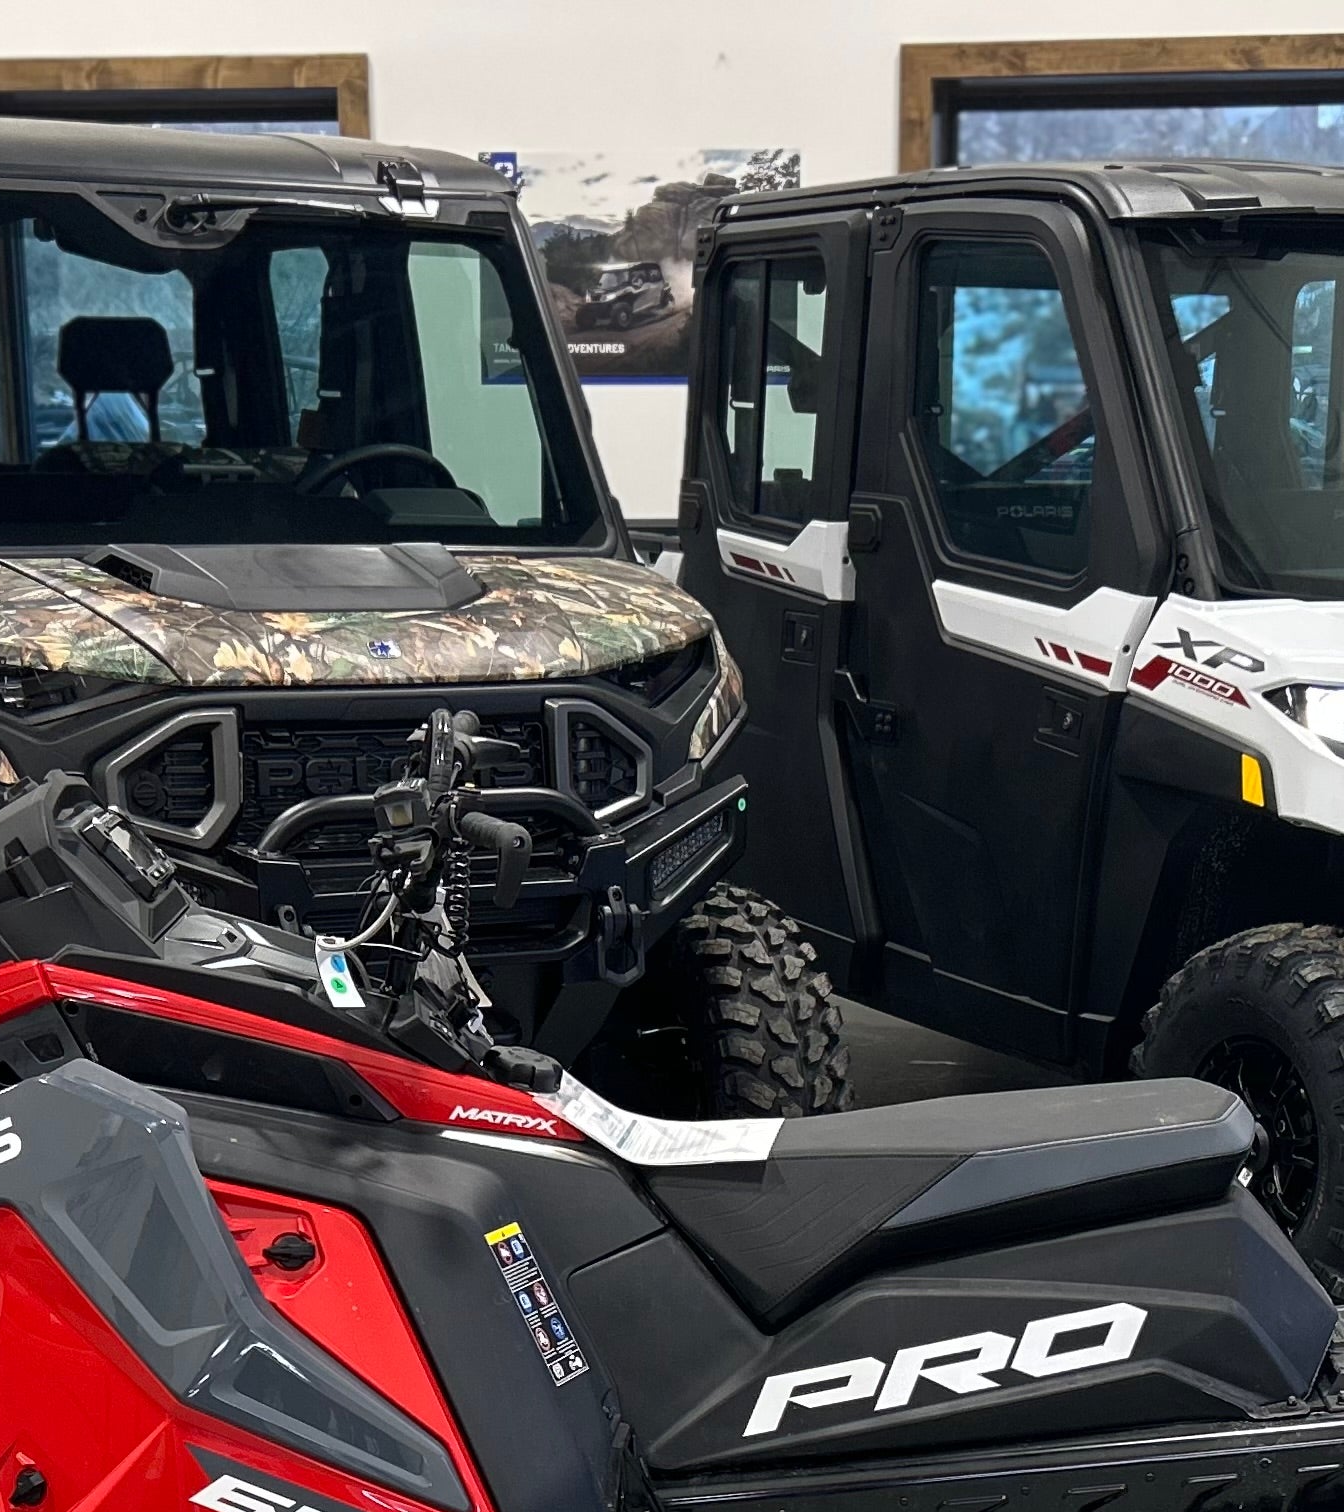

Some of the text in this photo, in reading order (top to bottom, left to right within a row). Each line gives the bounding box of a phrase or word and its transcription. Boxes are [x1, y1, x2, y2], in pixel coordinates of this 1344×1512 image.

[567, 343, 625, 354] DVENTURES
[997, 506, 1074, 518] POLARIS
[1152, 627, 1265, 673] XP
[1167, 662, 1236, 698] 1000
[449, 1105, 558, 1136] MATRYX
[742, 1302, 1149, 1438] PRO
